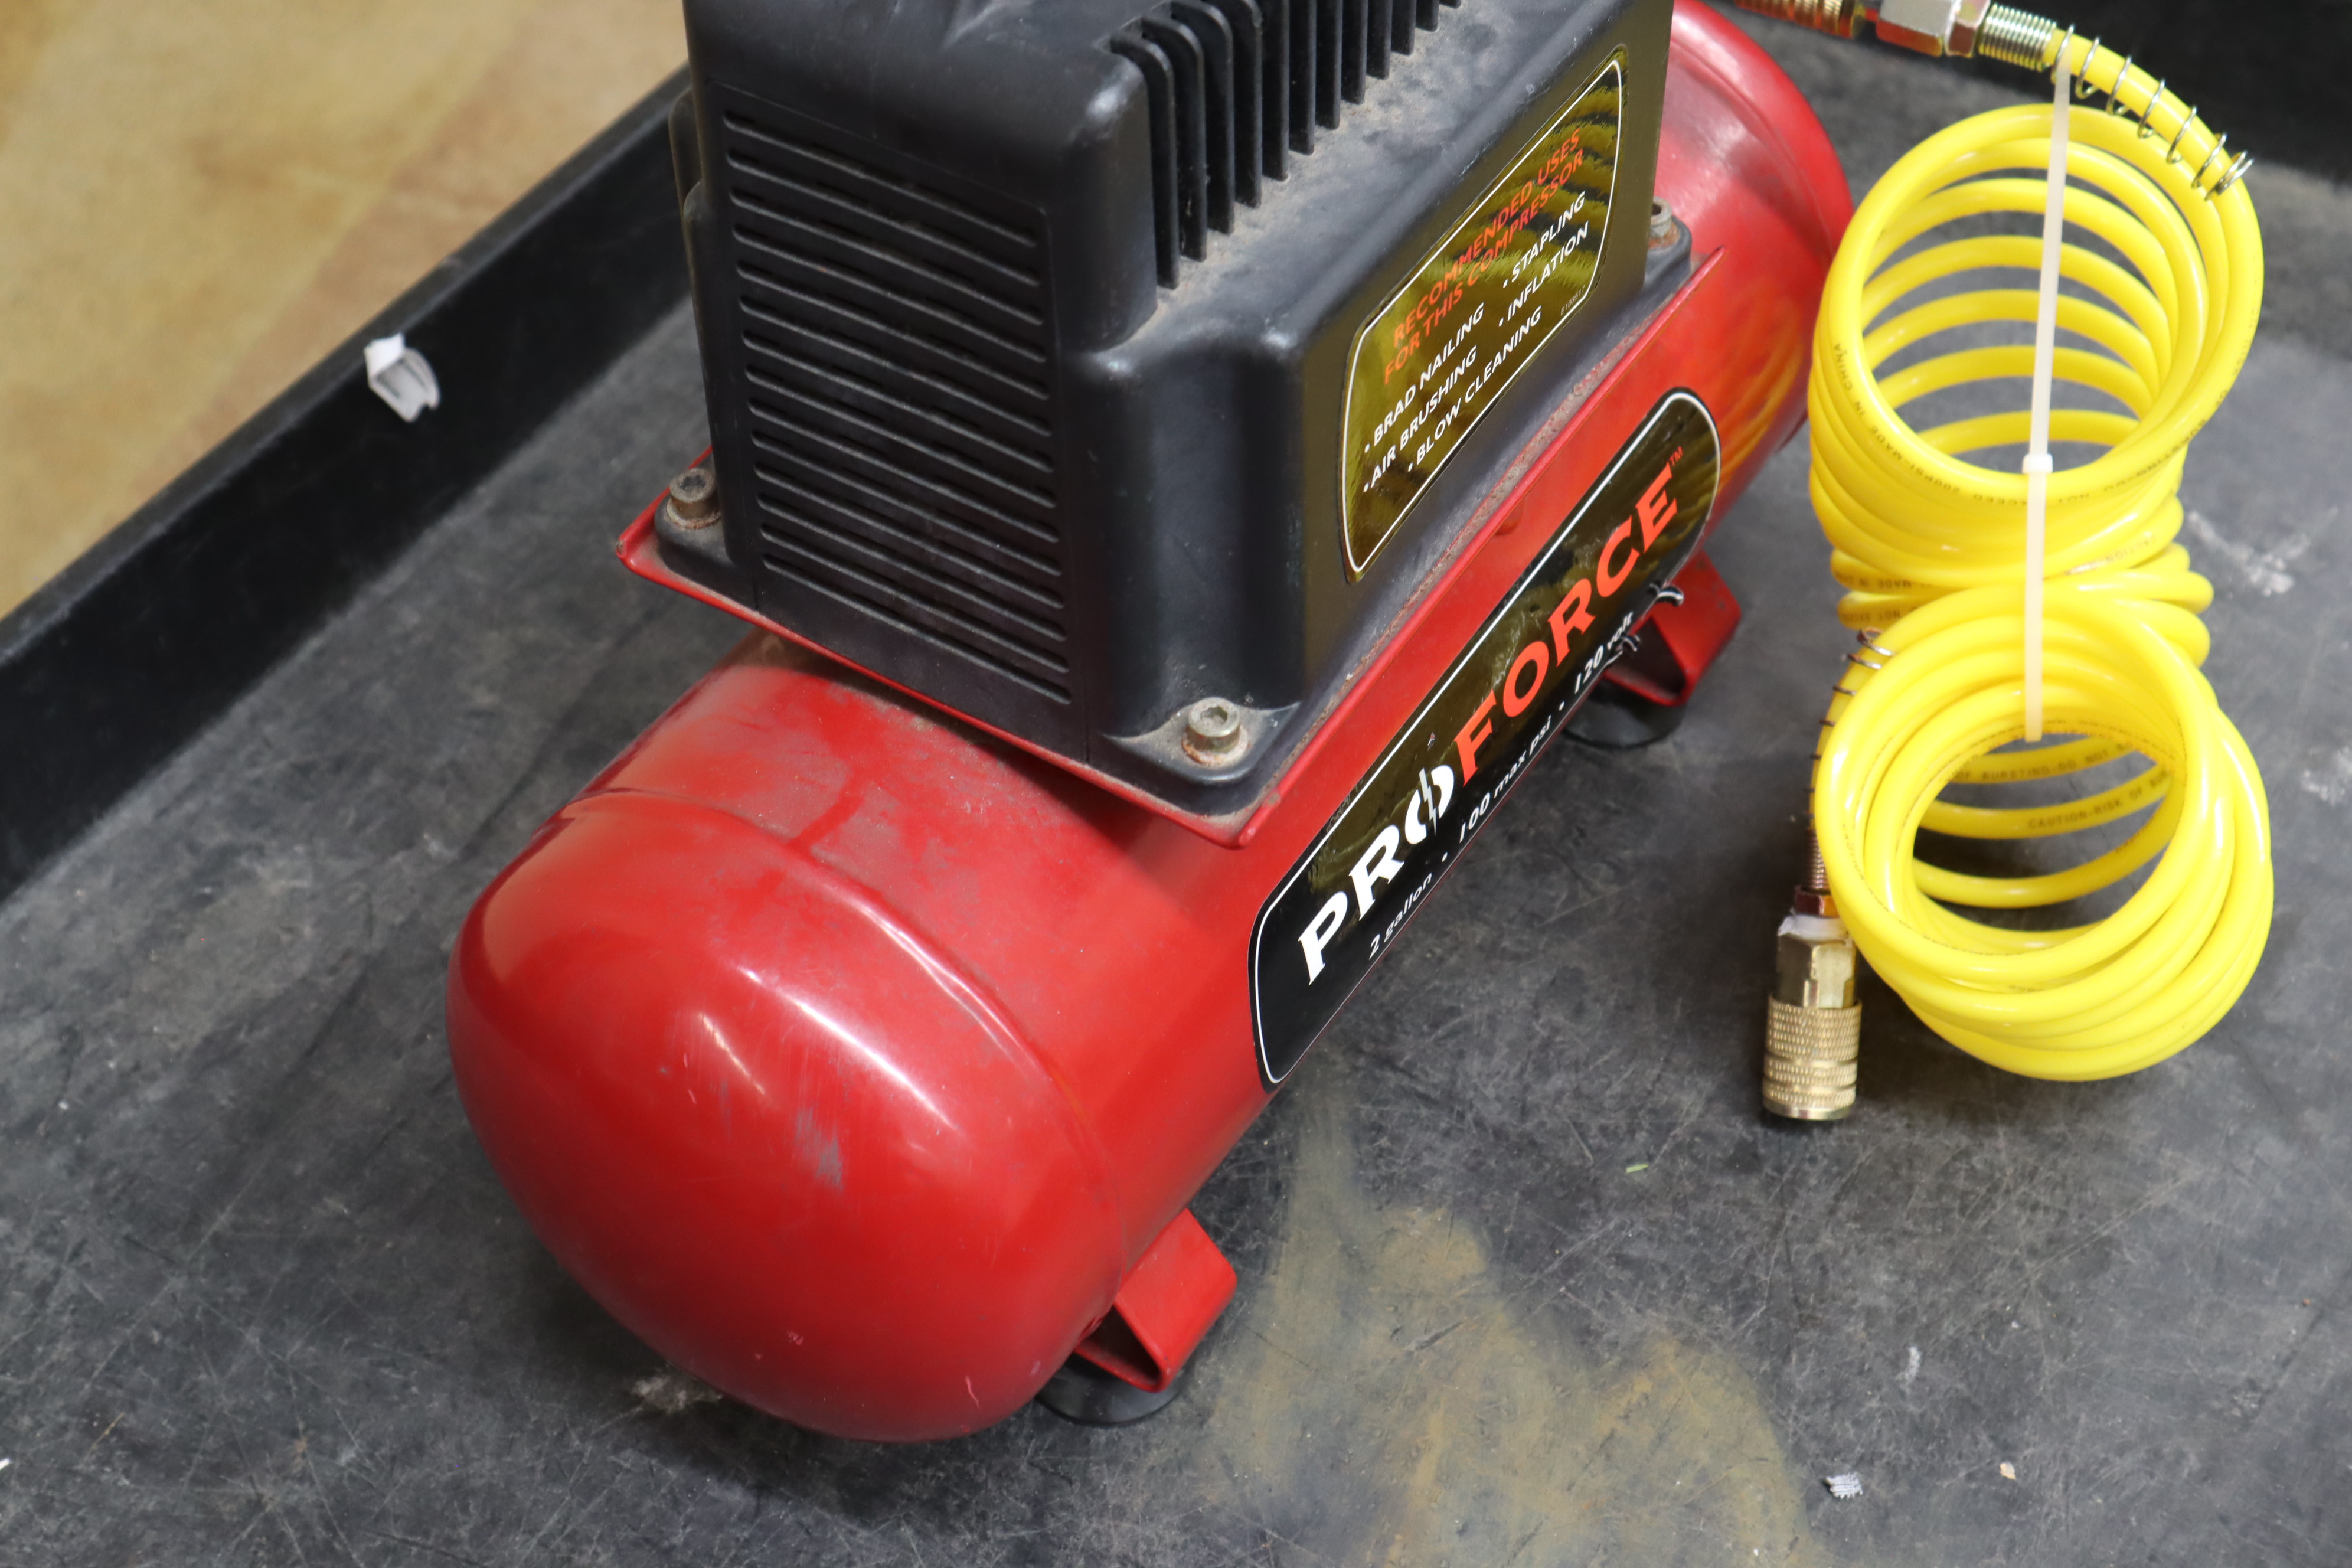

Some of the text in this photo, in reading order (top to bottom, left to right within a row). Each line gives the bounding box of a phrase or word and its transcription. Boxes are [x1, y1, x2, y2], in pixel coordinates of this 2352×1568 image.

[1384, 149, 1584, 385] FOR THIS COMPRESSOR
[1394, 128, 1580, 347] RECOMMENDED USES
[1507, 221, 1589, 322] INFLATION
[1511, 191, 1585, 283] STAPLING
[1370, 345, 1477, 489] AIR BRUSHING
[1374, 302, 1484, 447] BRAD NAILING
[1416, 305, 1541, 466] BLOW CLEANING
[1834, 342, 1853, 390] CHINA
[1854, 401, 1865, 416] IN
[1574, 610, 1634, 694] 120 volt
[1459, 714, 1551, 844] 100 max psi
[1368, 873, 1432, 961] 2 gallon
